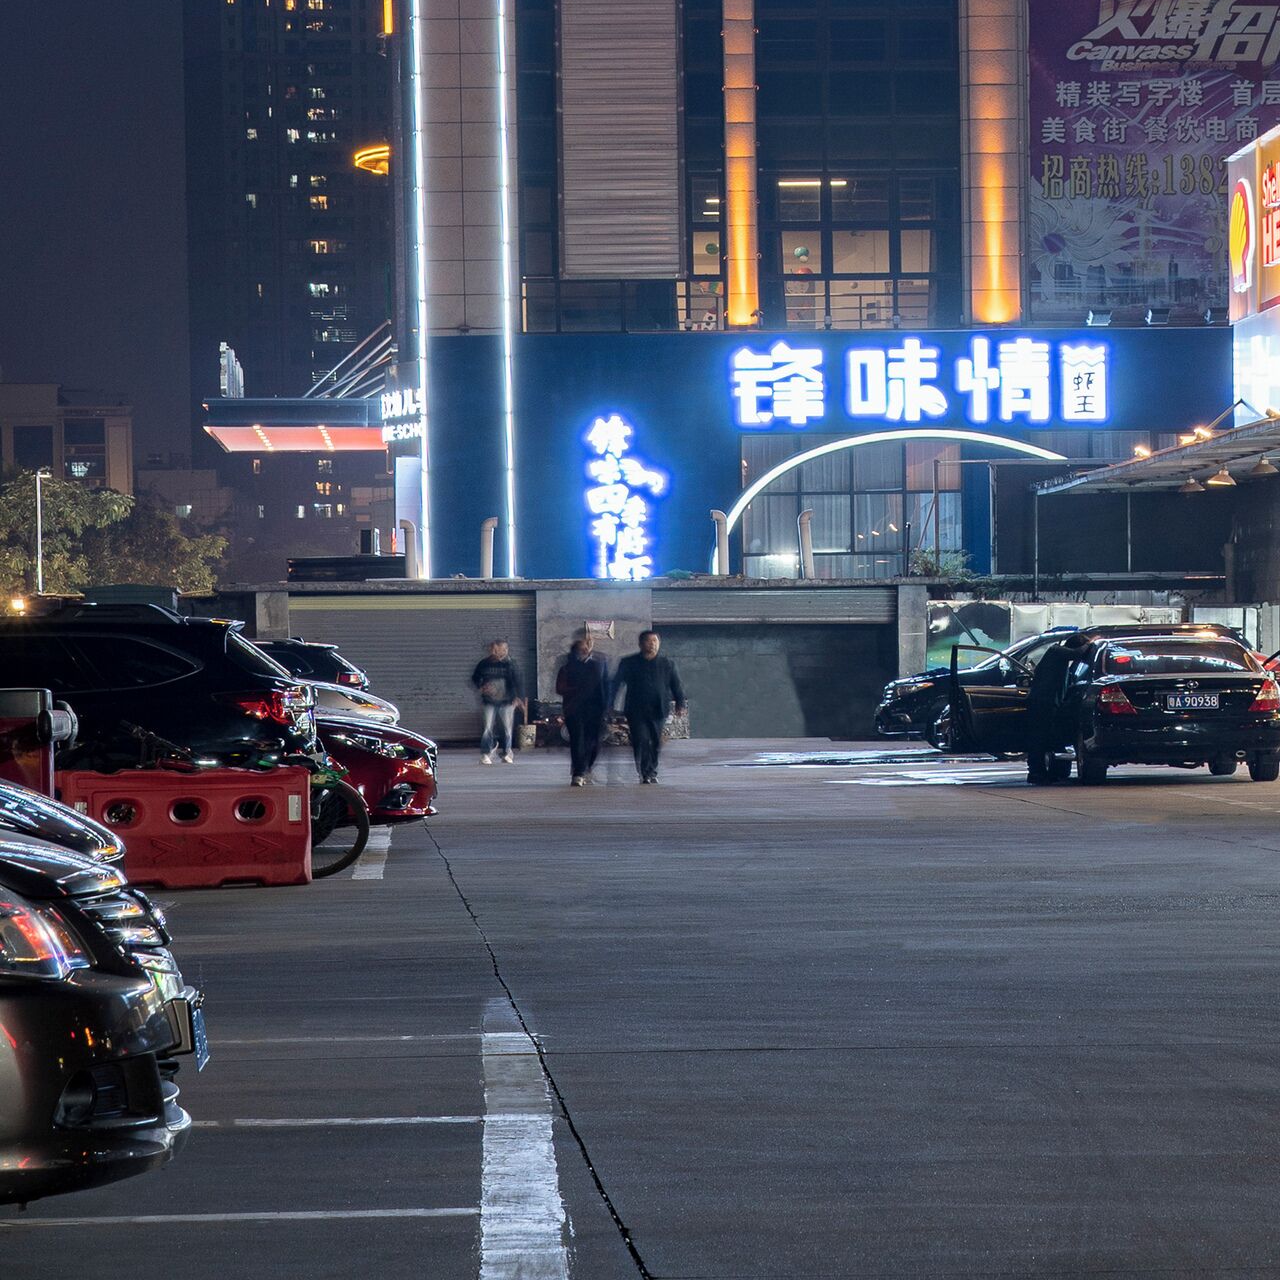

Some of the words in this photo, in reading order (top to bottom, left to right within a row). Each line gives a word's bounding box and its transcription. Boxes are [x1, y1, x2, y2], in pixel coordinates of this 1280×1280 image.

[1066, 40, 1194, 61] Canvass
[1055, 80, 1204, 108] 精装写字楼
[1041, 116, 1127, 144] 美食街
[1143, 115, 1260, 144] 餐饮电商
